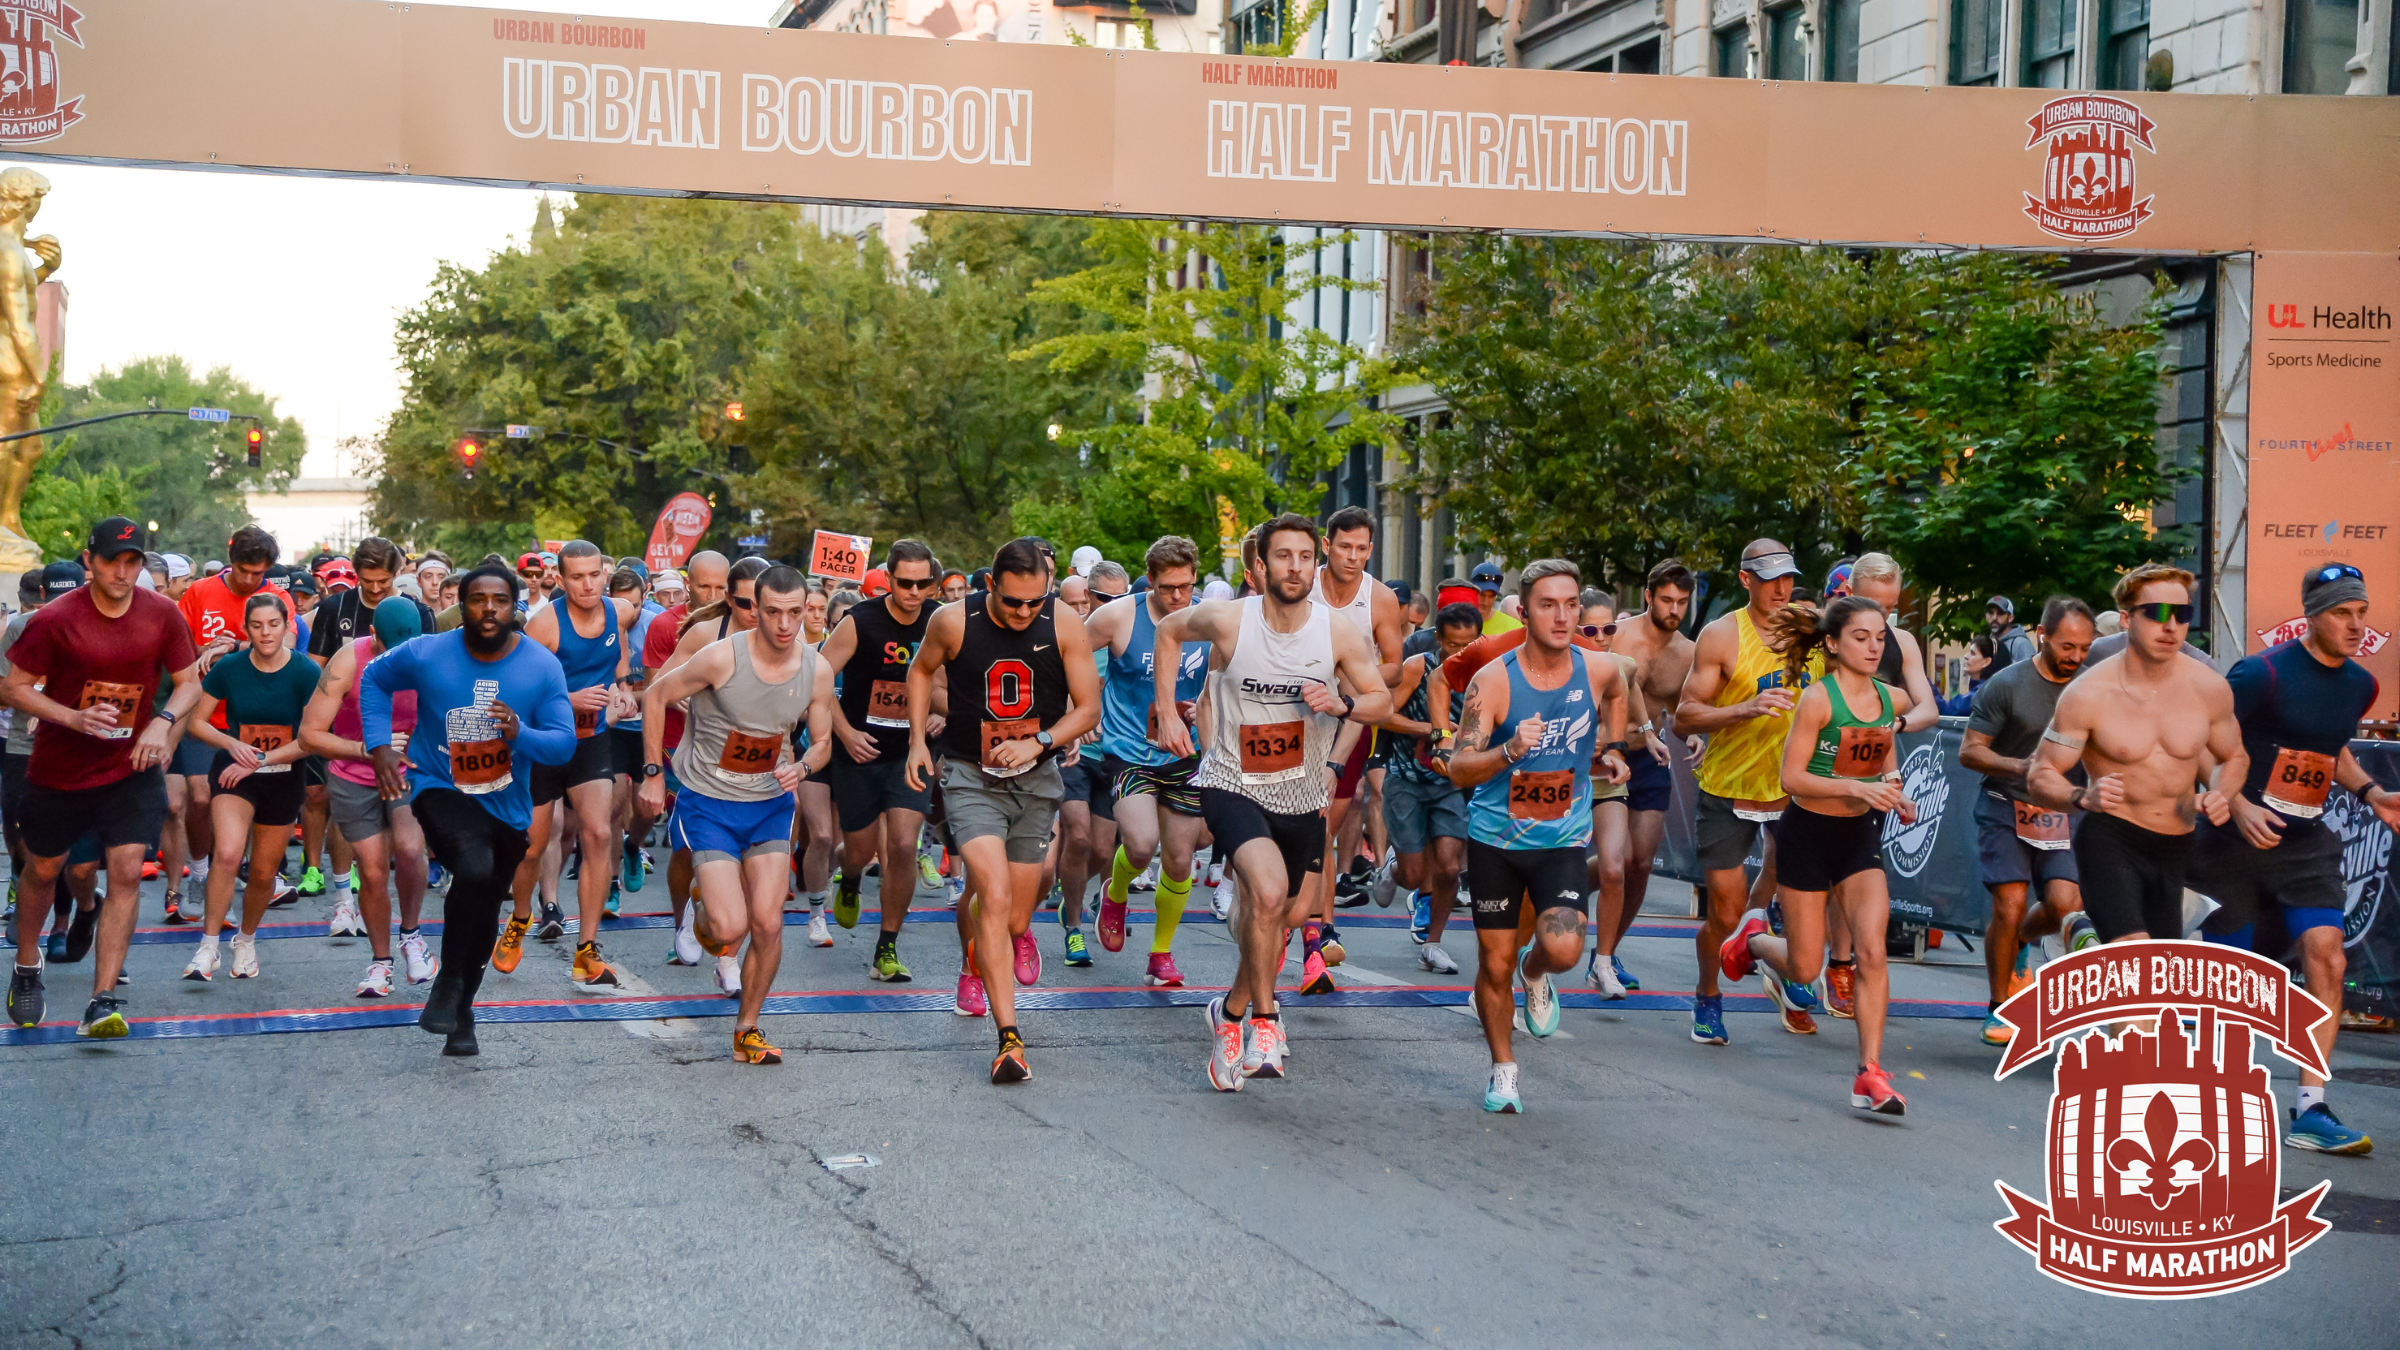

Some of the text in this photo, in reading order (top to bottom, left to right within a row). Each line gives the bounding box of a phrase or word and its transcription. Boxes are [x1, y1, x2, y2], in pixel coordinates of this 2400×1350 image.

[493, 18, 646, 50] URBAN BOURBON
[1202, 62, 1337, 89] HALF MARATHON
[25, 107, 36, 115] KY
[503, 57, 1033, 166] URBAN BOURBON
[2047, 101, 2136, 127] URBAN BOURBON
[0, 118, 57, 135] RATHON
[1207, 100, 1688, 196] HALF MARATHON
[2060, 206, 2117, 216] LOUISVILLE KY
[2043, 214, 2132, 233] HALF MARATHON
[2313, 305, 2391, 329] Health
[2267, 352, 2381, 369] Sports Medicine
[2259, 439, 2392, 451] FOURTH STREET
[2264, 524, 2387, 539] FLEET FEET
[822, 547, 857, 565] 1:40
[2298, 548, 2352, 558] LOUISVILLE
[820, 561, 856, 574] PACER
[202, 615, 225, 638] 22
[874, 691, 908, 706] 154
[251, 737, 281, 751] 412
[1245, 735, 1300, 756] 1334
[1530, 733, 1563, 750] EET
[455, 749, 508, 771] 1800
[732, 745, 773, 762] 284
[1850, 743, 1883, 761] 105
[1904, 754, 1922, 778] ORTS
[2282, 764, 2325, 789] 849
[1512, 784, 1570, 804] 2436
[2017, 810, 2064, 828] 2497
[1893, 828, 1935, 869] COMMISSION
[2344, 887, 2377, 936] ISSION
